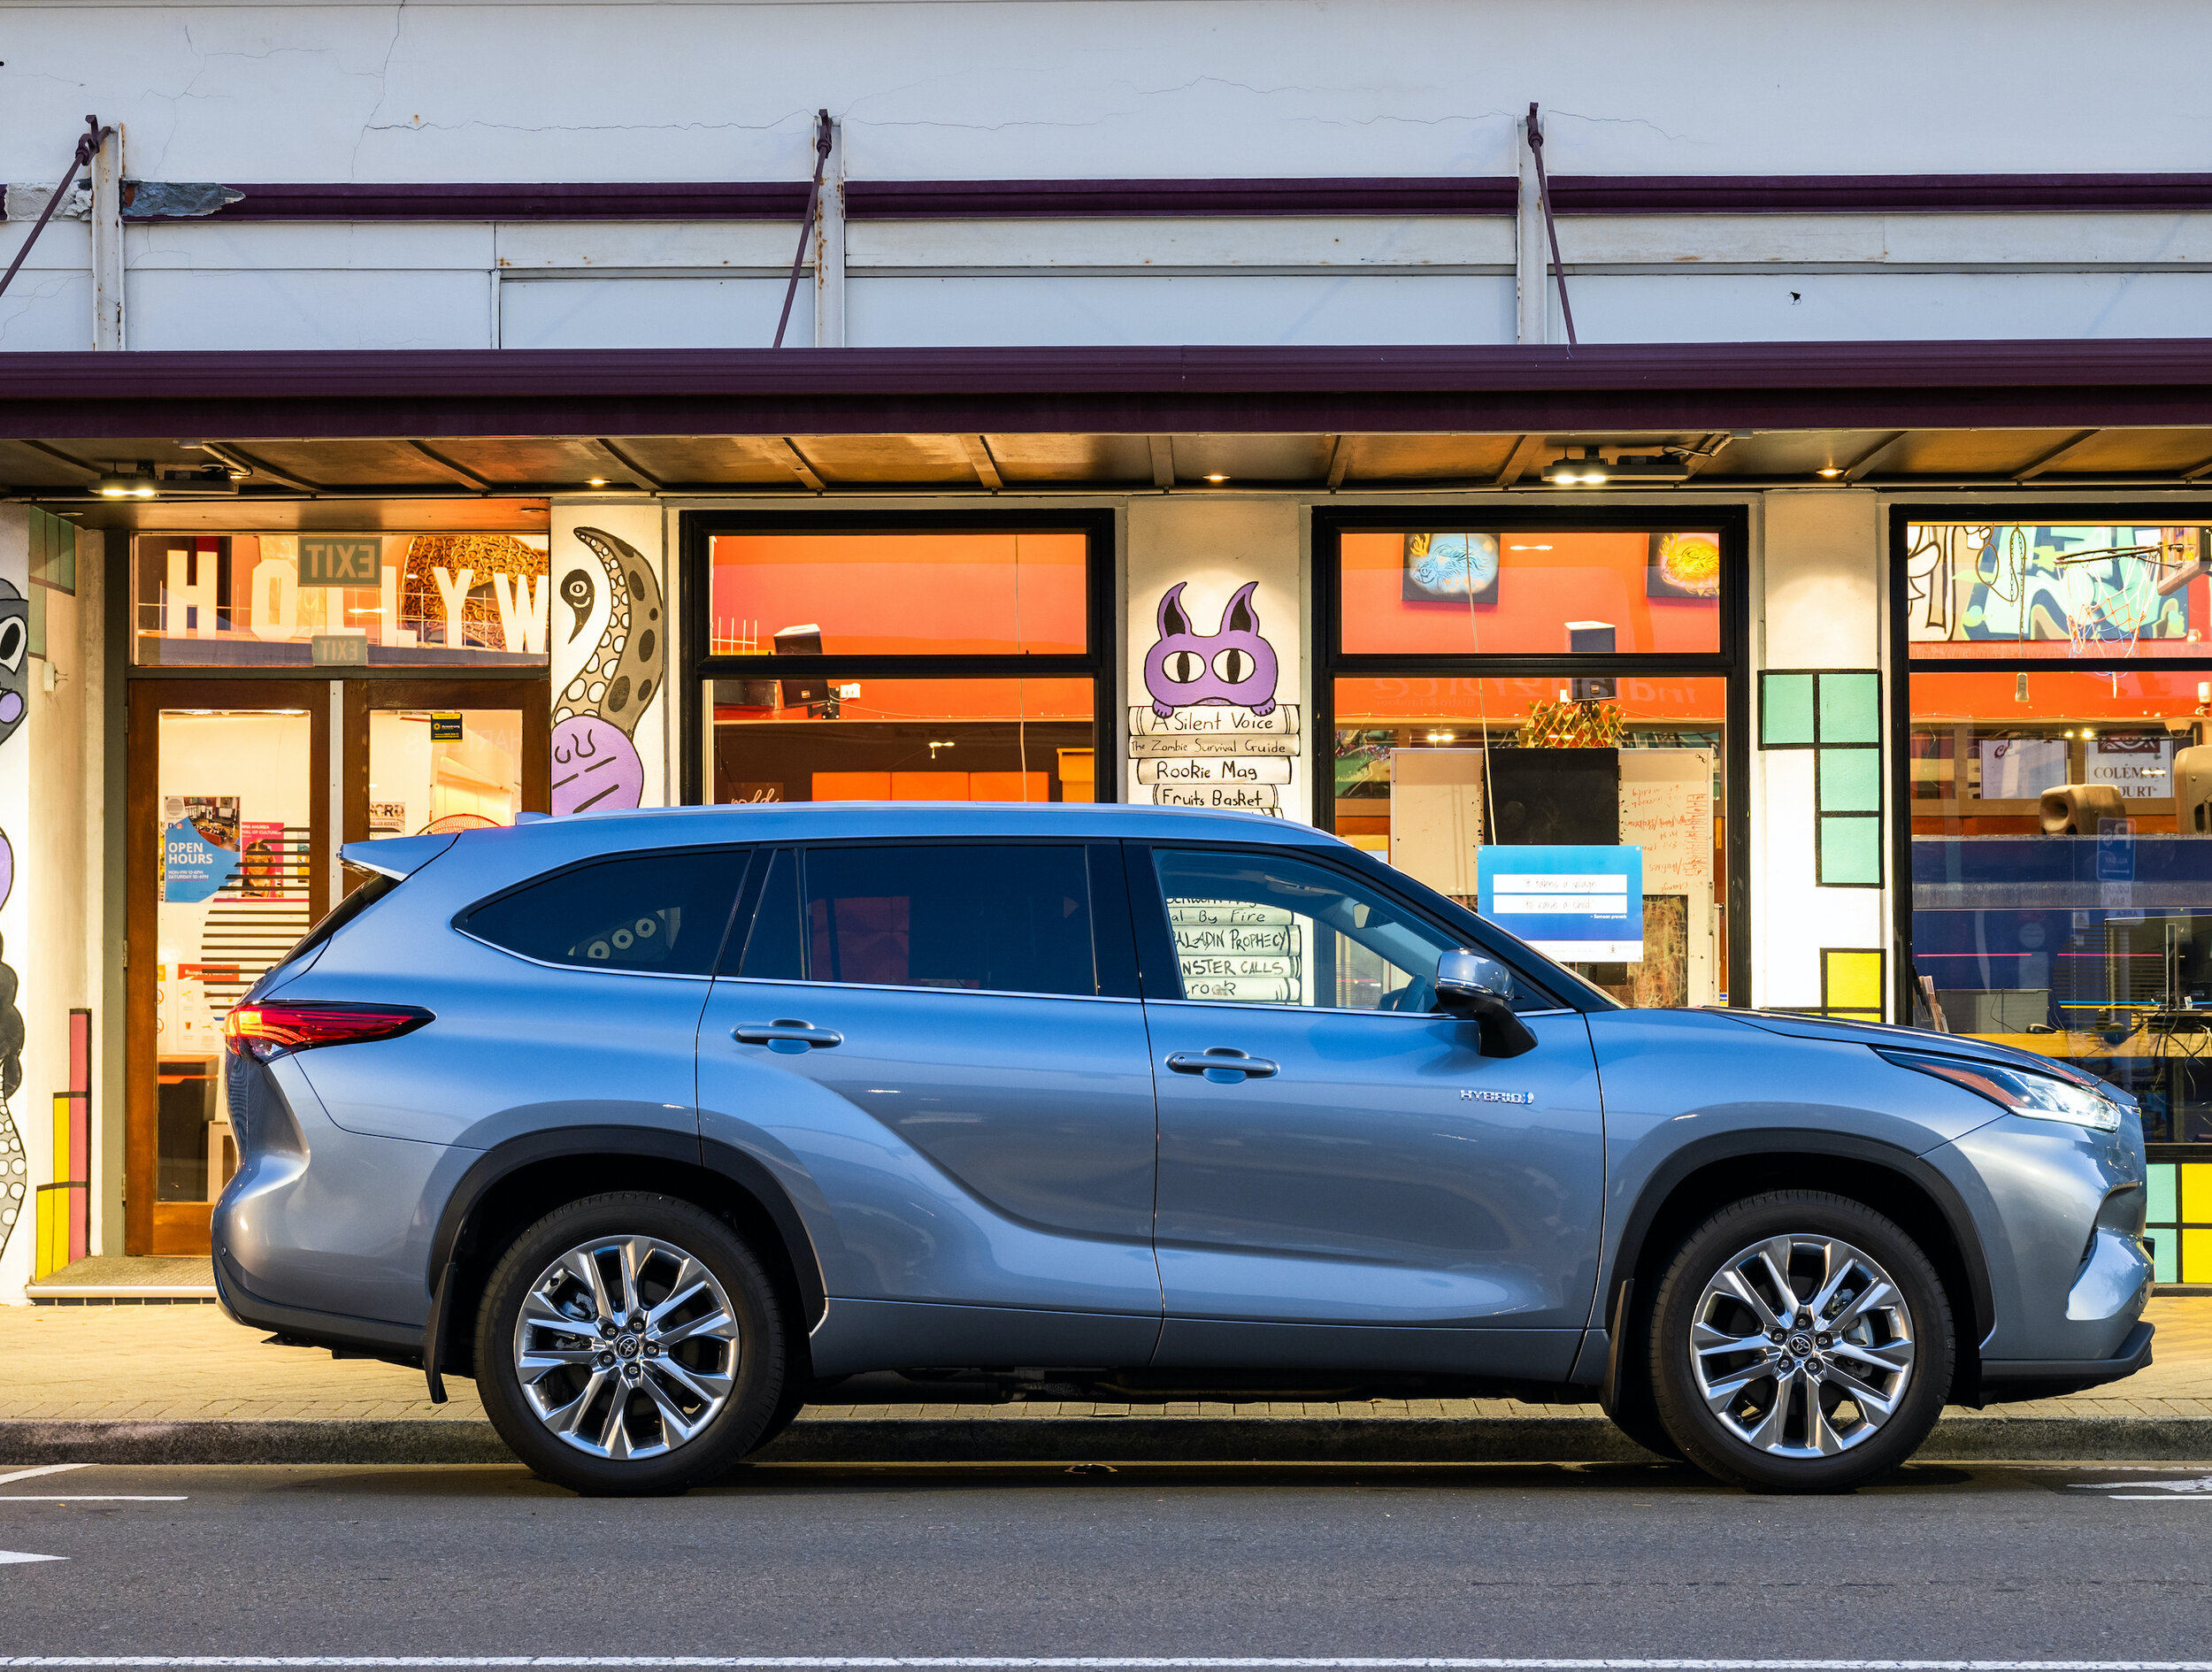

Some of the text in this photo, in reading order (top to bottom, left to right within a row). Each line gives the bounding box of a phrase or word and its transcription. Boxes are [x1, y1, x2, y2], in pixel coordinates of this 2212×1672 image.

[1151, 711, 1273, 731] A Silent Voice
[1131, 737, 1286, 753] The Zombie Survival Guide
[1156, 760, 1257, 780] Rookie Mag
[2093, 766, 2166, 778] COLEMAN
[1163, 788, 1263, 806] Fruits Basket
[2120, 786, 2154, 797] OURT
[168, 842, 204, 853] OPEN
[168, 854, 213, 864] HOURS
[1198, 910, 1217, 924] By
[1231, 909, 1266, 923] Fire
[1240, 961, 1284, 974] CALLS
[1460, 1089, 1525, 1103] HYBRID
